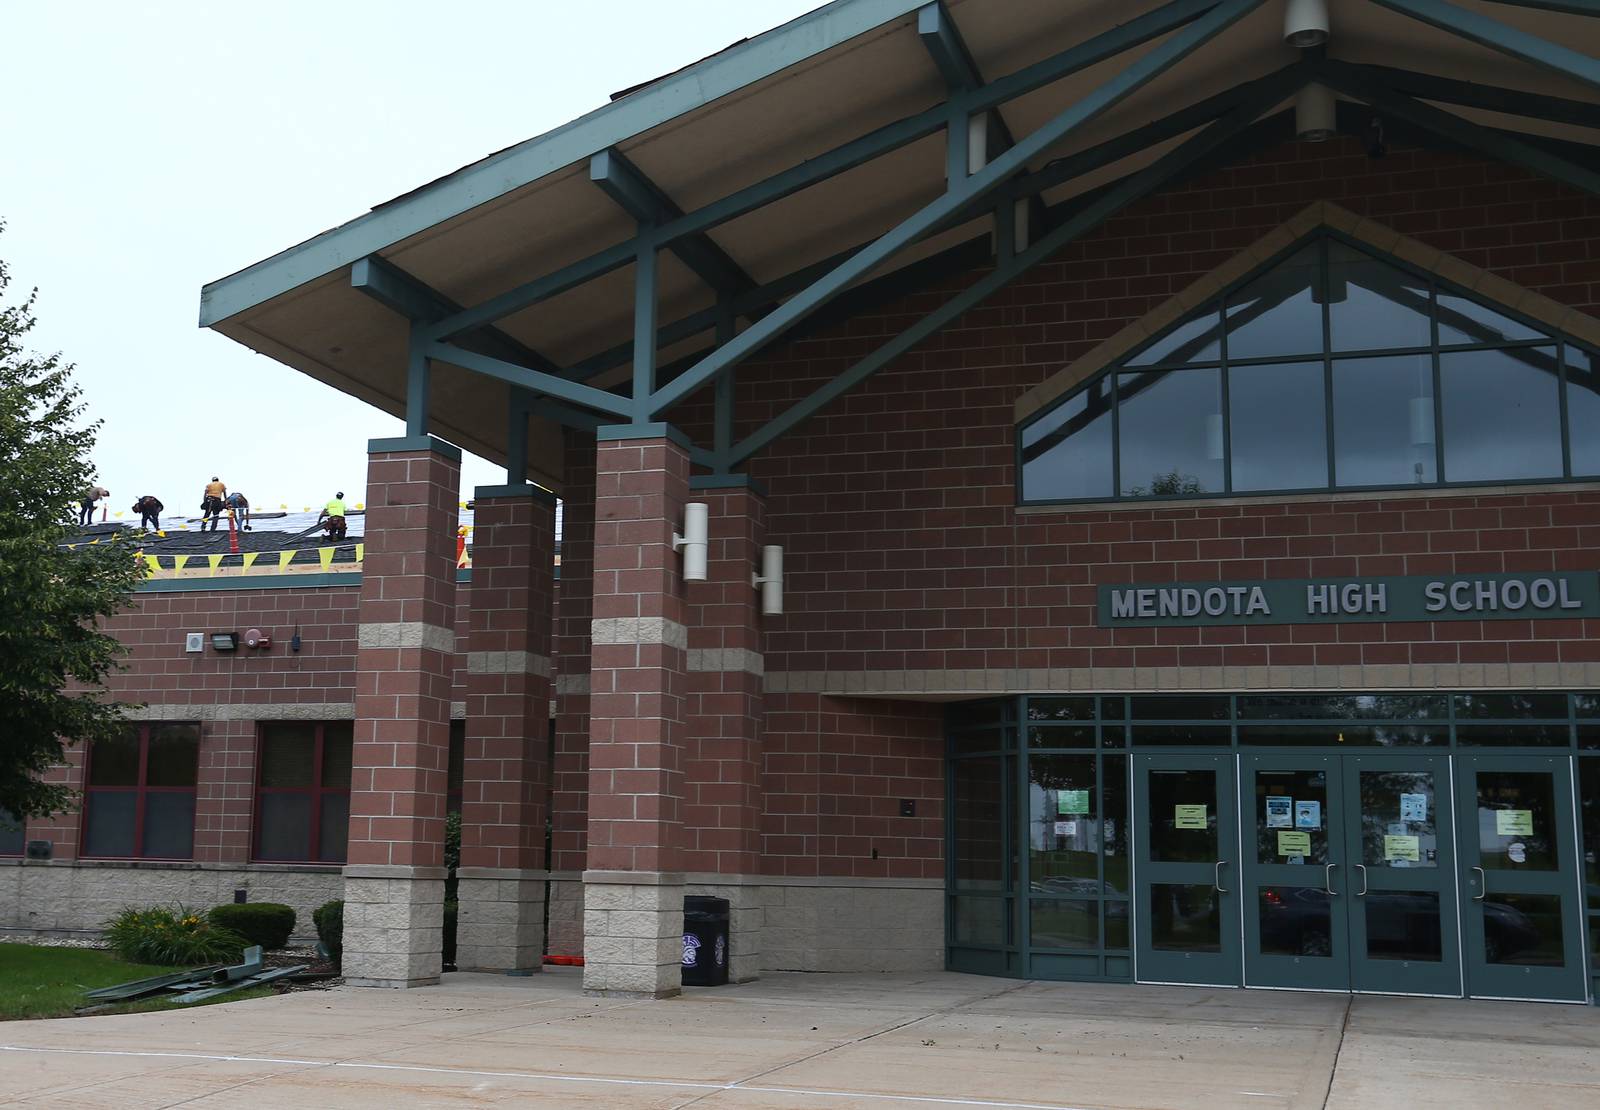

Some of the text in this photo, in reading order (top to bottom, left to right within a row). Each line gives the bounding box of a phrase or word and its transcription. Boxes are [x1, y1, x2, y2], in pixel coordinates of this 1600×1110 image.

[1110, 577, 1582, 618] MENDOTA HIGH SCHOOL
